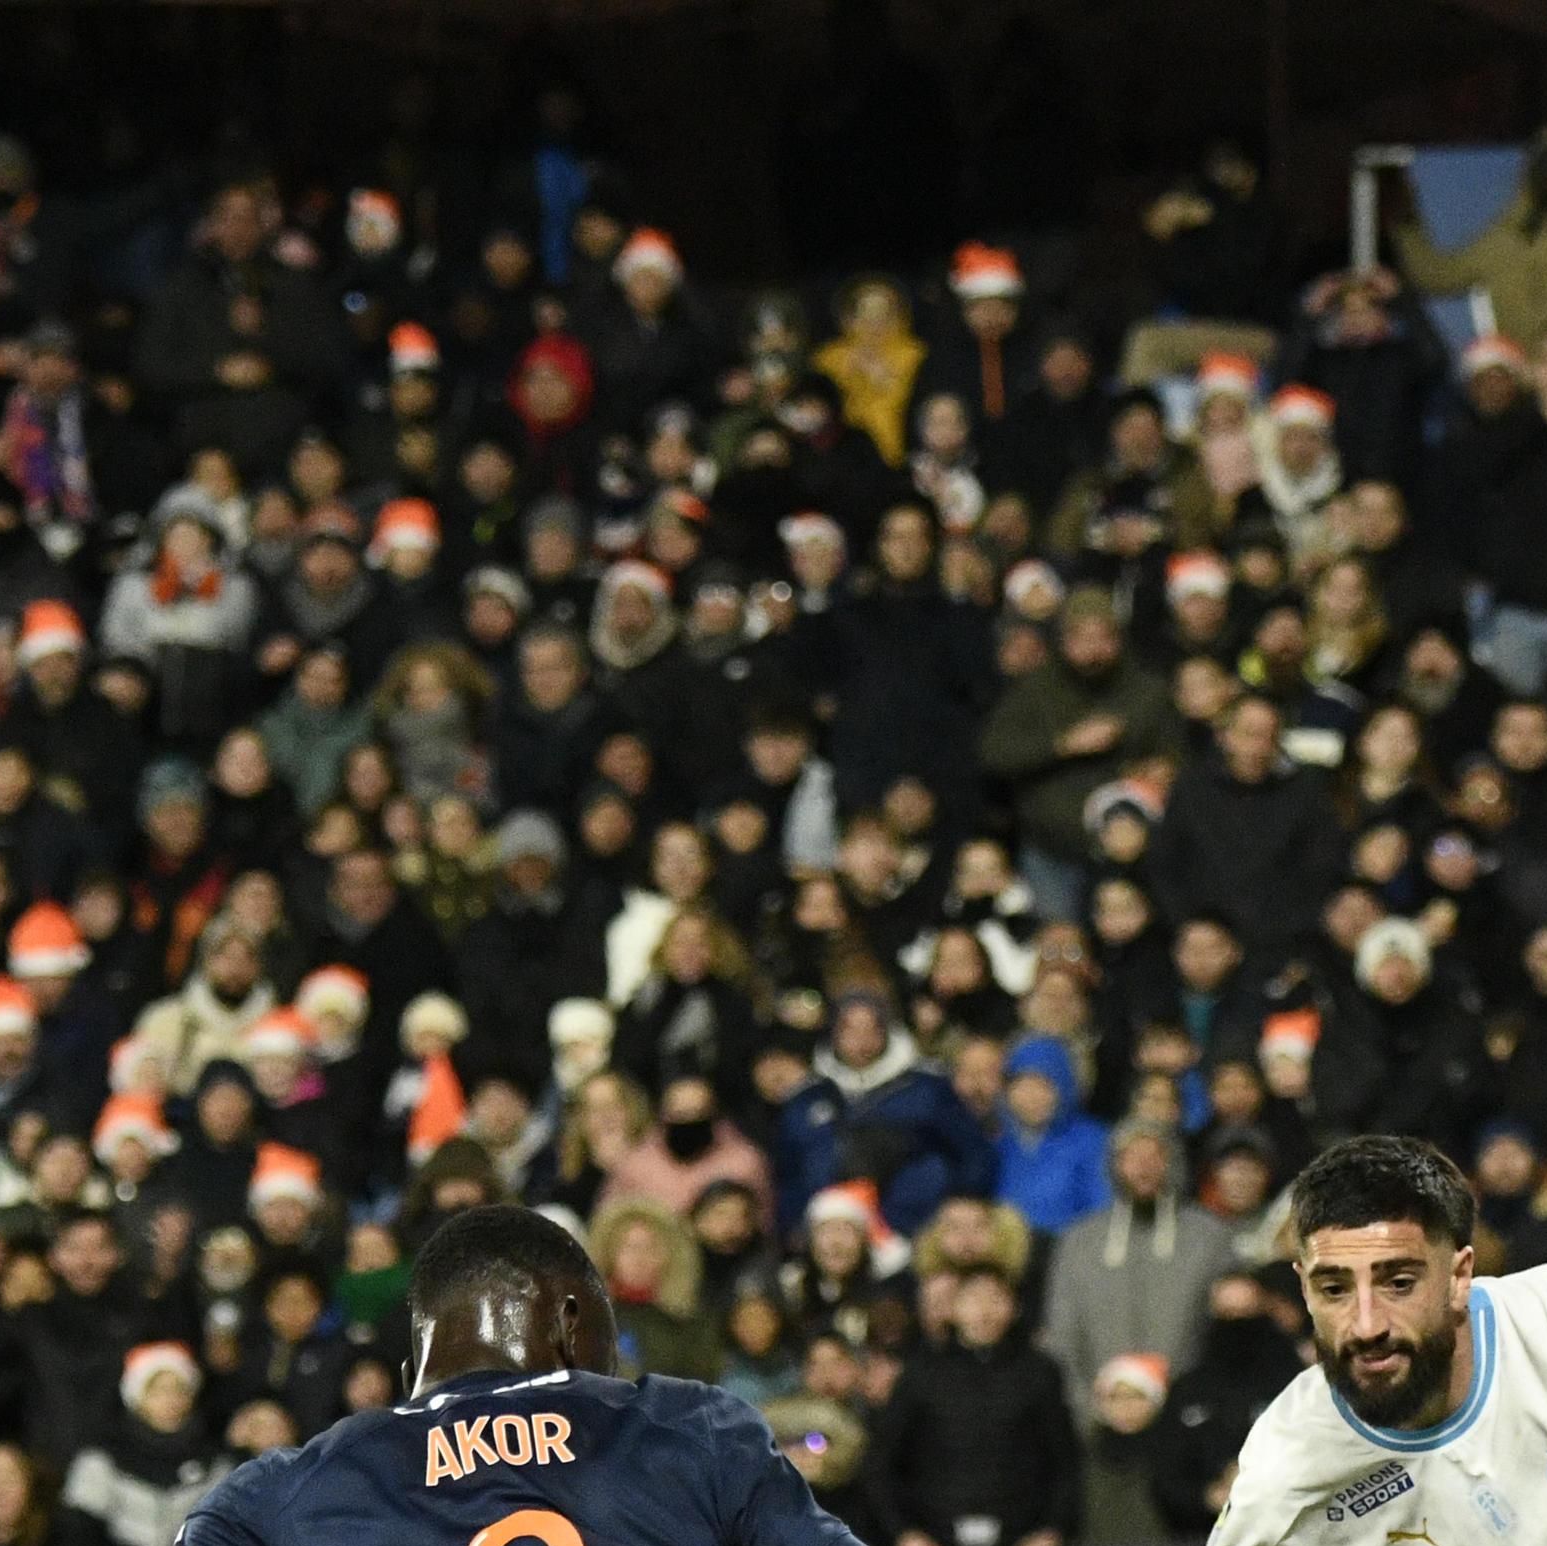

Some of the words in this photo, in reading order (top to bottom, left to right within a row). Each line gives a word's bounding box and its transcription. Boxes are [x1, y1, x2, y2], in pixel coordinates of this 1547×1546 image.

[424, 1411, 577, 1487] AKOR
[1335, 1461, 1405, 1505] PARIONS
[1353, 1474, 1410, 1516] SPORT
